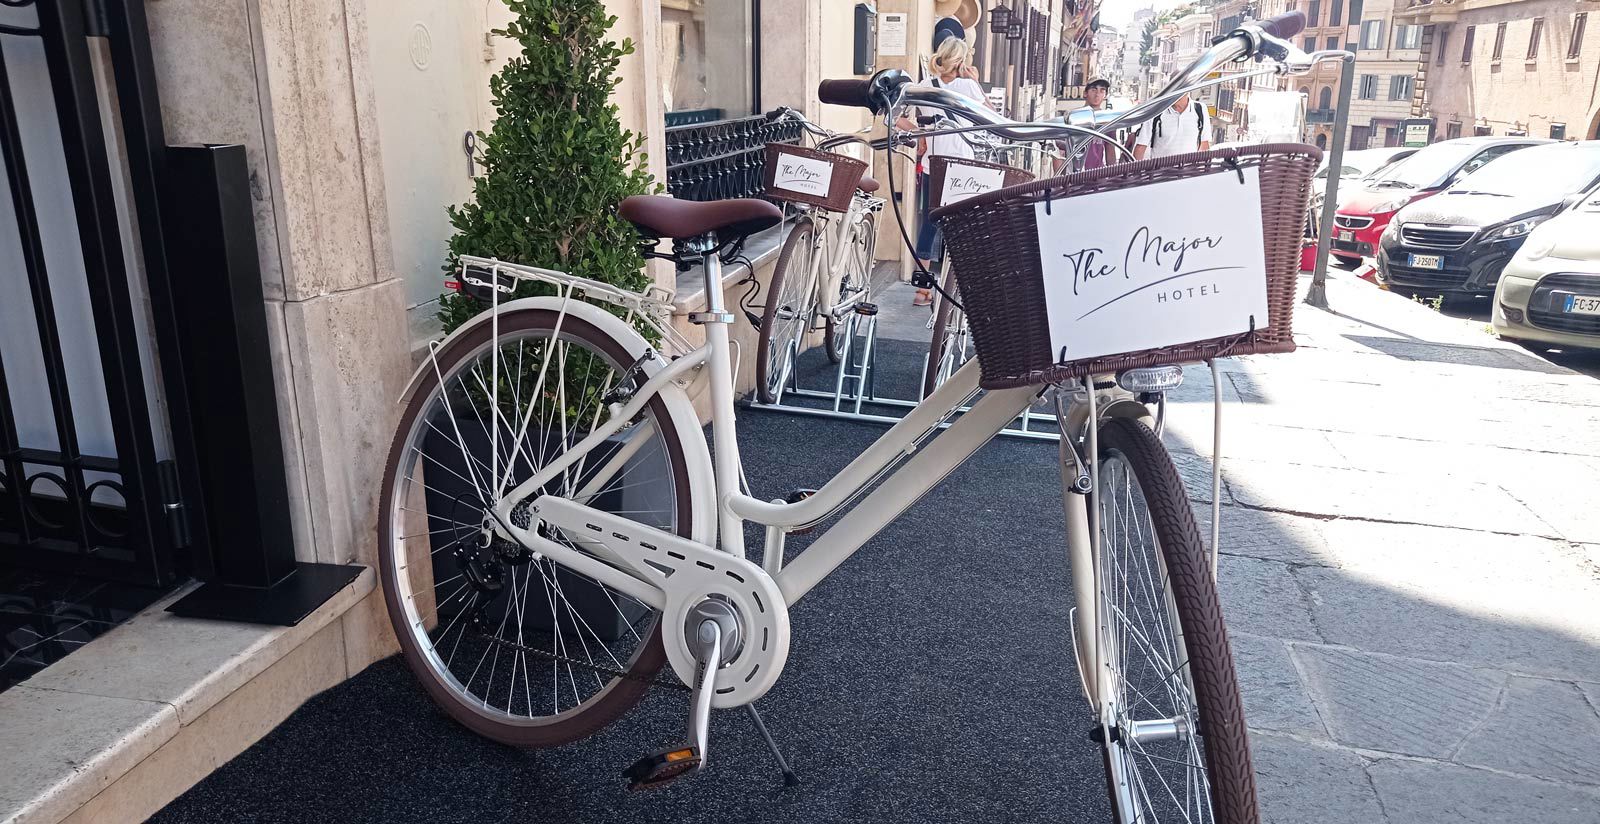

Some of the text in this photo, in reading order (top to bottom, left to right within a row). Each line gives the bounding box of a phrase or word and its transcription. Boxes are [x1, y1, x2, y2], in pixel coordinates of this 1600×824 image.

[950, 176, 992, 193] The Major
[1063, 226, 1223, 296] The Major
[1157, 283, 1220, 303] HOTEL
